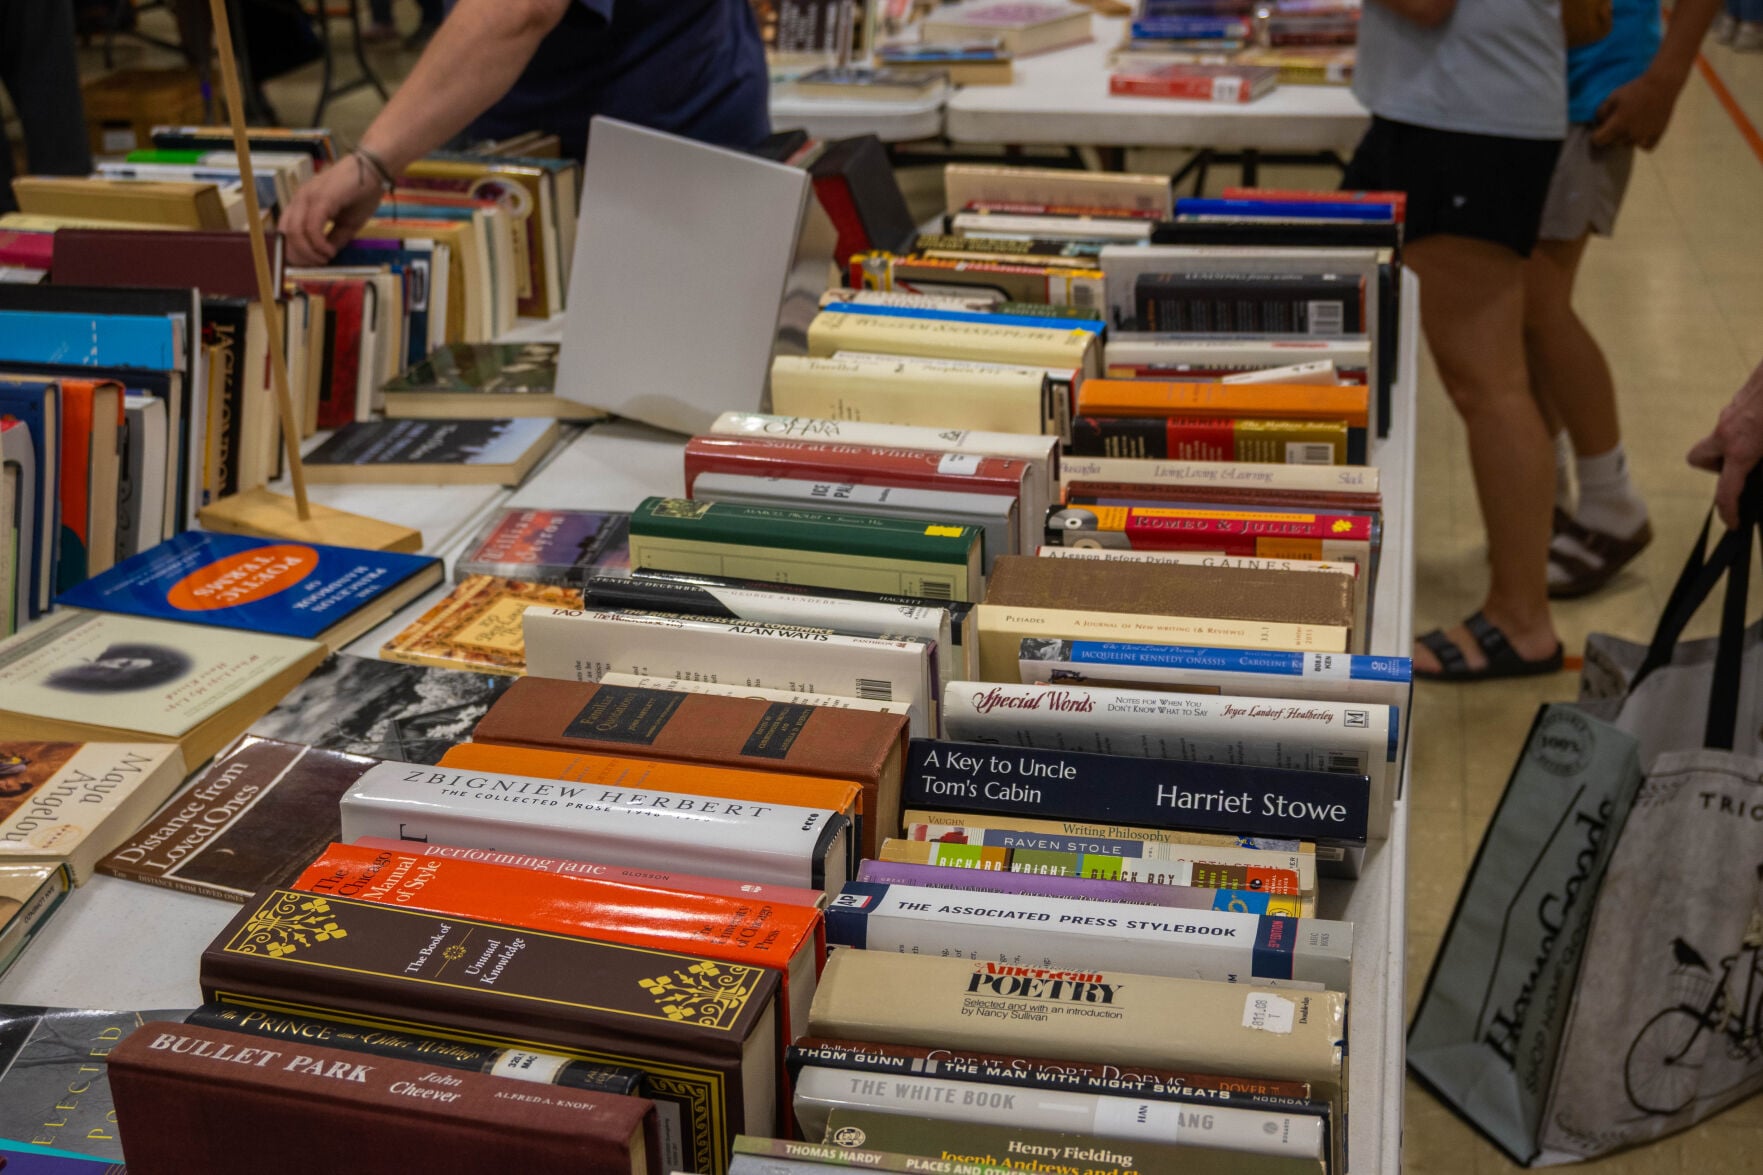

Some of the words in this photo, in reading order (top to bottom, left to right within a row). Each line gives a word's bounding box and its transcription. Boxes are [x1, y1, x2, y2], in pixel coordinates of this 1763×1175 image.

[869, 447, 925, 459] White
[1135, 516, 1208, 530] ROMEO
[1215, 520, 1232, 530] &
[1240, 520, 1315, 534] JULIET
[1061, 552, 1100, 561] Lesson
[1104, 554, 1142, 563] Before
[1202, 558, 1291, 571] GAINES
[193, 556, 275, 596] TERMS
[216, 556, 303, 602] POETIC
[645, 581, 704, 592] DECEMBER
[731, 591, 777, 599] GEORGE
[780, 595, 836, 605] SAUNDERS
[879, 595, 922, 605] HACKETT
[552, 608, 583, 617] TAO
[1005, 615, 1046, 624] PLEIADES
[681, 613, 729, 624] ACROSS
[729, 618, 764, 628] LAKE
[764, 623, 835, 635] CONSTANCE
[728, 626, 777, 637] ALAN
[778, 630, 830, 641] WATTS
[1081, 651, 1136, 662] JACQUELINE
[1139, 654, 1184, 663] KENNEDY
[1186, 656, 1226, 666] ONASSIS
[1239, 656, 1286, 667] CAROLINE
[972, 687, 1041, 714] Special
[1046, 690, 1096, 714] Words
[1107, 704, 1132, 712] DON'T
[1133, 705, 1156, 713] KNOW
[1158, 706, 1180, 715] WHAT
[1182, 708, 1192, 716] TO
[1194, 708, 1208, 717] SAY
[1115, 696, 1140, 705] NOTES
[1219, 704, 1247, 719] Joyce
[1248, 706, 1285, 720] Landorf
[923, 751, 940, 768] A
[946, 752, 984, 777] Key
[989, 759, 1012, 775] to
[1018, 758, 1077, 780] Uncle
[80, 752, 153, 804] Maya
[402, 770, 587, 800] ZBIGNIEW
[598, 789, 774, 818] HERBERT
[441, 788, 472, 798] THE
[475, 791, 559, 807] COLLECTED
[566, 802, 611, 813] PROSE
[921, 775, 978, 797] Tom's
[984, 781, 1042, 804] Cabin
[2, 769, 97, 842] Angelou
[114, 801, 206, 863] Distance
[193, 762, 249, 801] from
[1156, 784, 1252, 815] Harriet
[1262, 793, 1347, 822] Stowe
[149, 820, 216, 870] Loved
[203, 785, 260, 828] Ones
[801, 812, 820, 831] ecco
[928, 815, 965, 826] VAUGHN
[1062, 823, 1106, 839] Writing
[1107, 826, 1171, 843] Philosophy
[1004, 837, 1061, 850] RAVEN
[1067, 842, 1122, 855] STOLE
[338, 852, 392, 895] Chicago
[424, 845, 555, 871] performing
[555, 861, 608, 875] jane
[621, 870, 670, 881] GLOSSON
[138, 874, 174, 888] DISTANCE
[175, 882, 197, 893] FROM
[198, 887, 223, 898] LOVED
[223, 891, 245, 902] ONES
[311, 868, 348, 892] The
[362, 856, 417, 900] Manual
[396, 879, 413, 902] of
[407, 860, 442, 890] Style
[1090, 868, 1138, 883] BLACK
[1148, 872, 1176, 886] BOY
[837, 895, 858, 907] AP
[744, 905, 773, 937] Chicago
[898, 901, 931, 912] THE
[938, 905, 1051, 922] ASSOCIATED
[1058, 915, 1118, 928] PRESS
[1126, 920, 1237, 938] STYLEBOOK
[405, 954, 428, 974] The
[418, 933, 443, 963] Book
[439, 923, 453, 938] of
[754, 929, 781, 951] Press
[465, 939, 501, 977] Unusual
[480, 937, 526, 984] Knowledge
[974, 962, 1104, 983] American
[967, 973, 1126, 1004] POETRY
[961, 1007, 973, 1017] by
[975, 1008, 1009, 1019] Nancy
[1010, 1011, 1048, 1021] Sullivan
[964, 997, 1006, 1010] Selected
[1007, 1001, 1027, 1011] and
[1029, 1004, 1049, 1012] with
[1066, 1006, 1123, 1019] introduction
[214, 1008, 236, 1020] The
[239, 1011, 337, 1040] PRINCE
[360, 1031, 409, 1048] Other
[416, 1039, 480, 1062] Writings
[148, 1033, 282, 1068] BULLET
[284, 1055, 376, 1083] PARK
[507, 1052, 524, 1068] 320.1
[521, 1055, 538, 1070] MAC
[417, 1071, 463, 1087] John
[797, 1048, 847, 1061] THOM
[854, 1054, 904, 1067] GUNN
[945, 1063, 978, 1074] THE
[986, 1067, 1027, 1079] MAN
[1036, 1072, 1080, 1084] WITH
[1088, 1077, 1145, 1091] NIGHT
[1153, 1084, 1230, 1100] SWEATS
[1252, 1095, 1311, 1107] NOONDAY
[1219, 1082, 1266, 1095] DOVER
[389, 1080, 462, 1103] Cheever
[494, 1090, 541, 1105] ALFRED
[543, 1097, 554, 1106] A.
[555, 1099, 597, 1111] KNOPF
[850, 1078, 888, 1096] THE
[895, 1083, 957, 1103] WHITE
[962, 1092, 1016, 1110] BOOK
[1137, 1104, 1148, 1123] HAN
[785, 1143, 838, 1161] THOMAS
[839, 1150, 882, 1165] HARDY
[941, 1151, 998, 1166] Joseph
[1001, 1157, 1079, 1175] Andrews
[1008, 1141, 1061, 1159] Henry
[1063, 1146, 1133, 1167] Fielding
[906, 1158, 951, 1173] PLACES
[952, 1163, 981, 1175] AND
